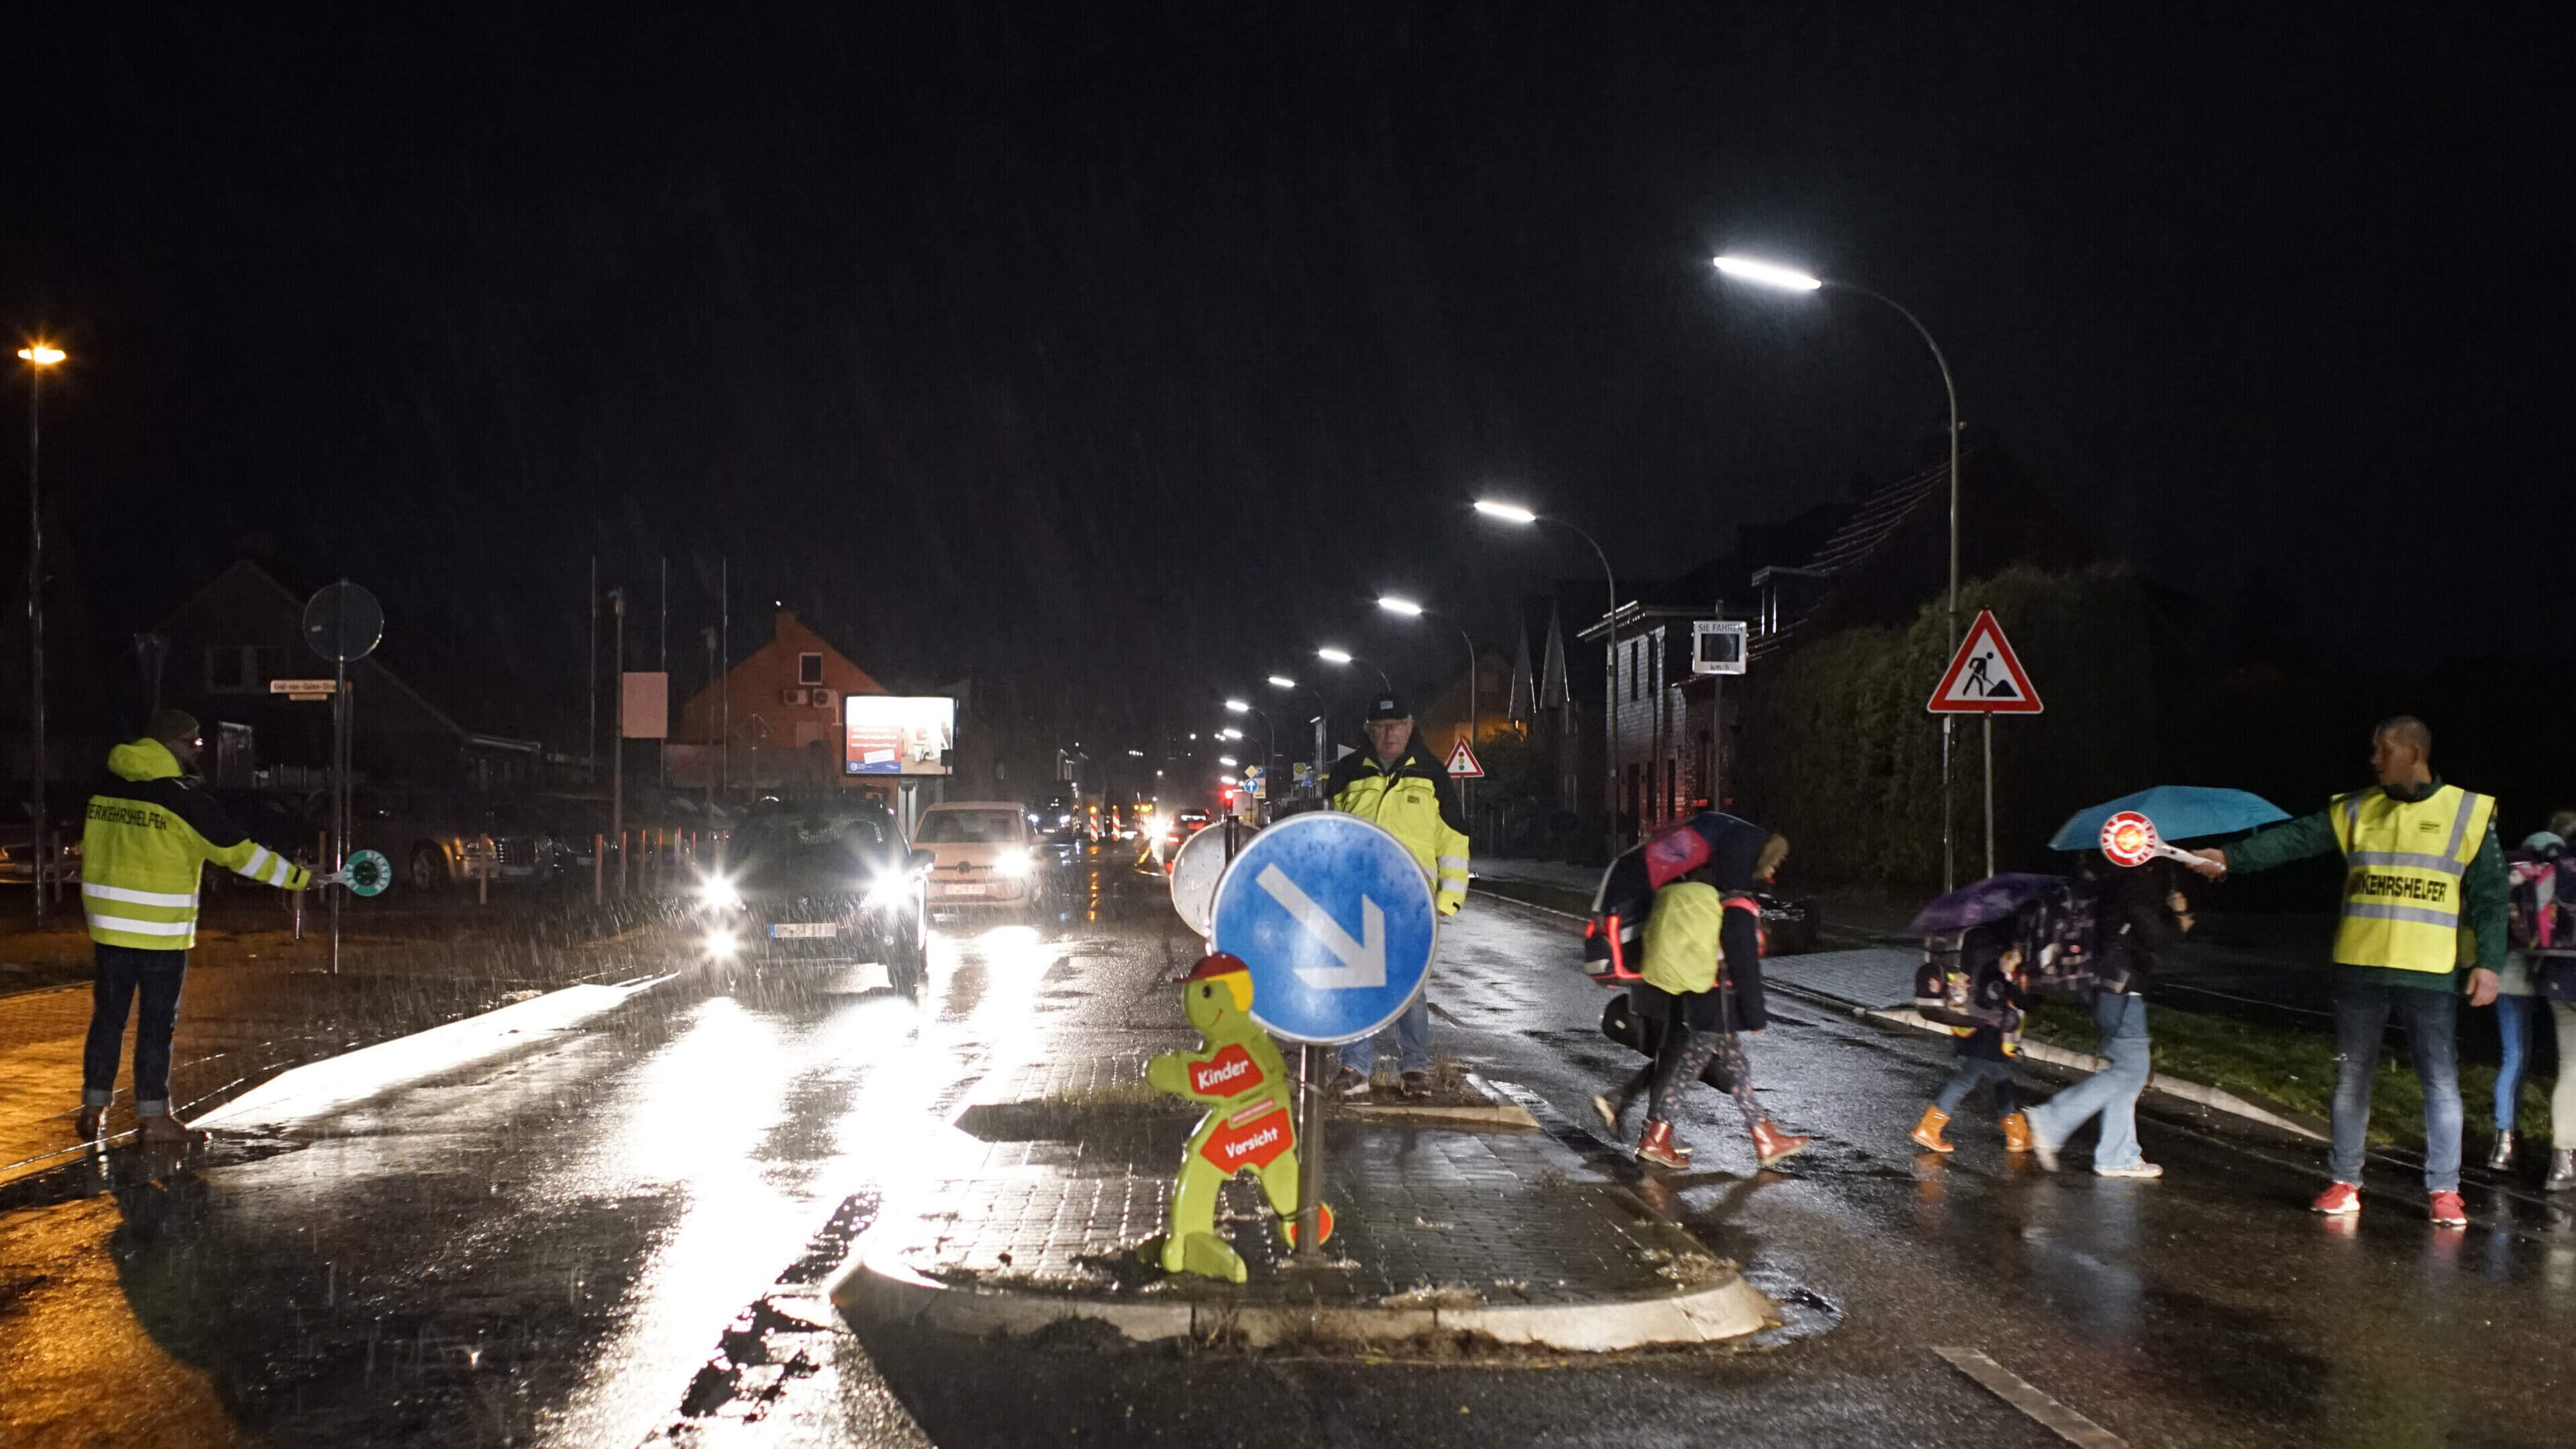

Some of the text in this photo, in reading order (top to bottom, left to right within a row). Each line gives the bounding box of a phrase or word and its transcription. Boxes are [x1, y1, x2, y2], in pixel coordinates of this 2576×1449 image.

[1698, 623, 1743, 633] SIE FAHREN
[87, 804, 167, 830] ERKEHRSHELFER
[1197, 1059, 1249, 1090] Kinder
[1225, 1127, 1278, 1159] Vorsicht
